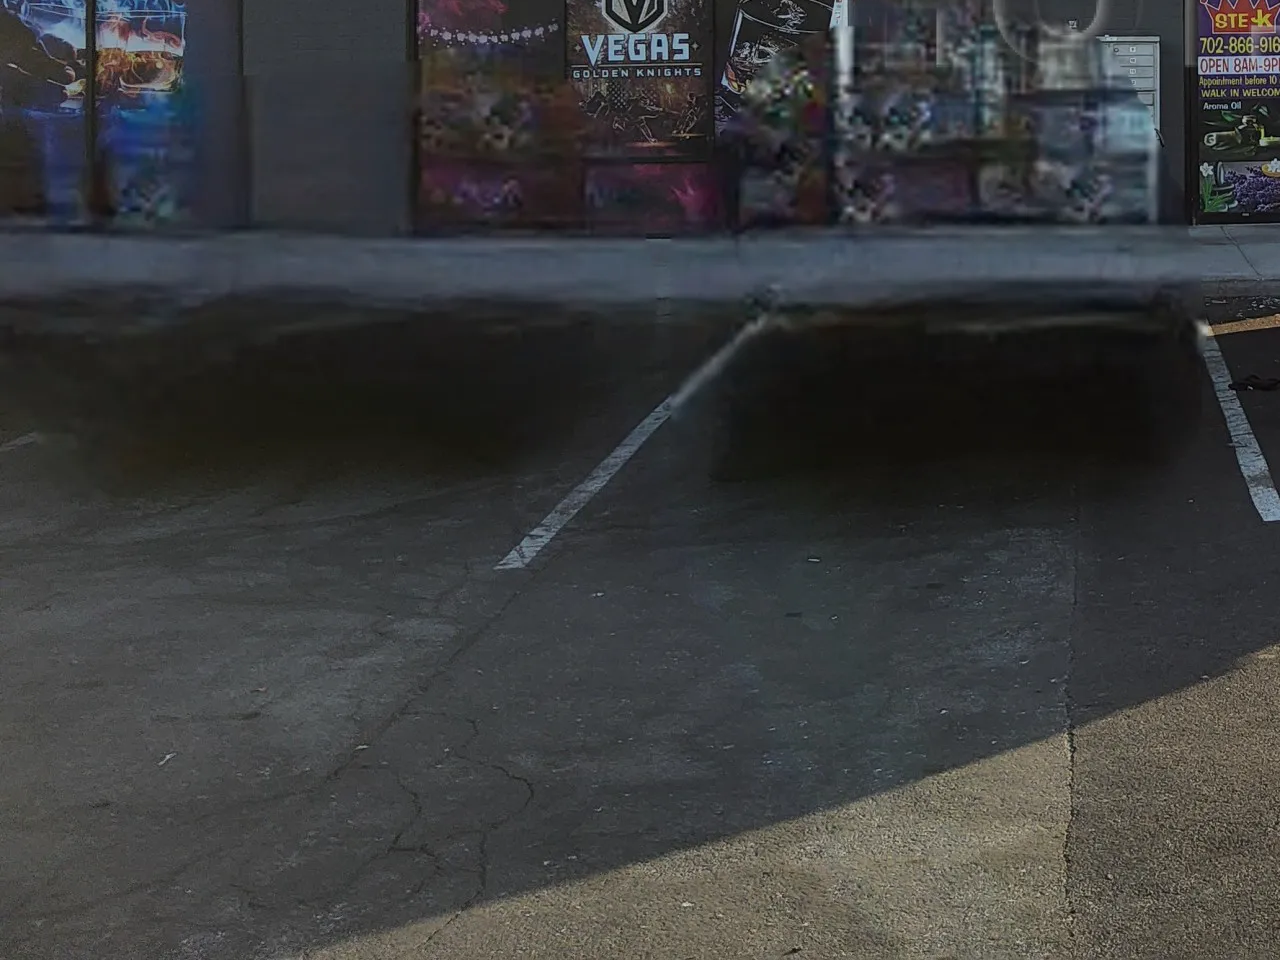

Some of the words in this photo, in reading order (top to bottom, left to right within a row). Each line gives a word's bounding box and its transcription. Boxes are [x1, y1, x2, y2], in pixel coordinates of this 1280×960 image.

[581, 33, 690, 67] VEGAS
[1200, 57, 1230, 73] OPEN
[573, 69, 629, 79] GOLDEN
[636, 67, 702, 78] KNIGHTS
[1199, 76, 1242, 89] Appointment
[1244, 75, 1267, 85] before
[1269, 74, 1277, 84] 10
[1201, 89, 1227, 98] WALK
[1230, 89, 1240, 98] IN
[1203, 102, 1229, 110] Aroma
